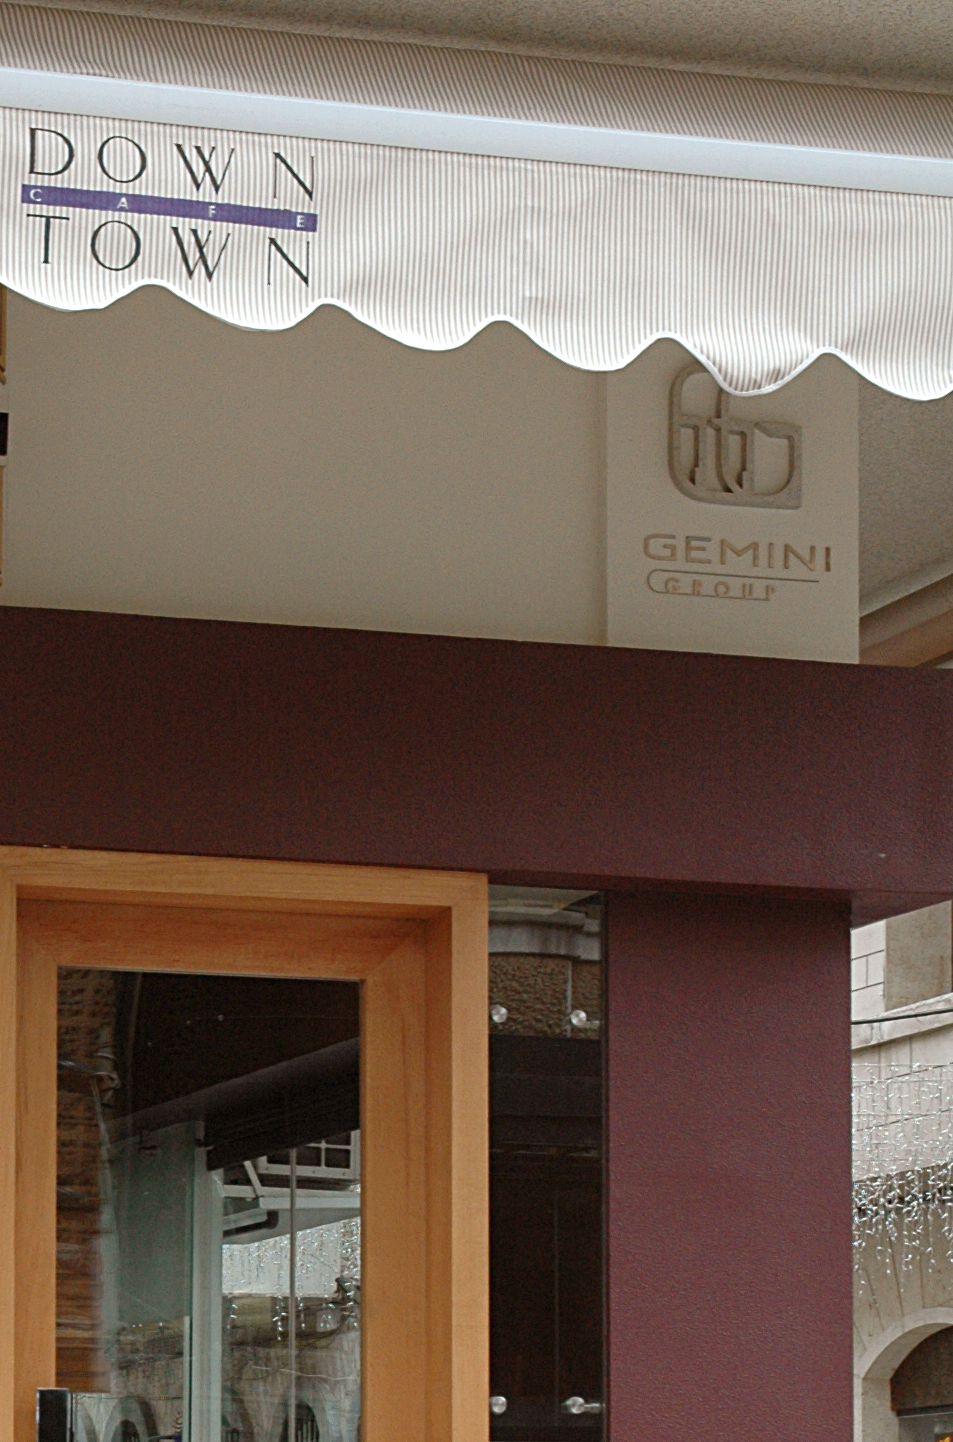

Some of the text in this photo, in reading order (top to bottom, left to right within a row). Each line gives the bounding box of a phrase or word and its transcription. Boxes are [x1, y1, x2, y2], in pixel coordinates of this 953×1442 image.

[28, 126, 316, 202] DOWN
[29, 187, 306, 229] CAFE
[25, 212, 311, 288] TOWN
[642, 533, 831, 573] GEMINI
[664, 577, 776, 601] GROUP
